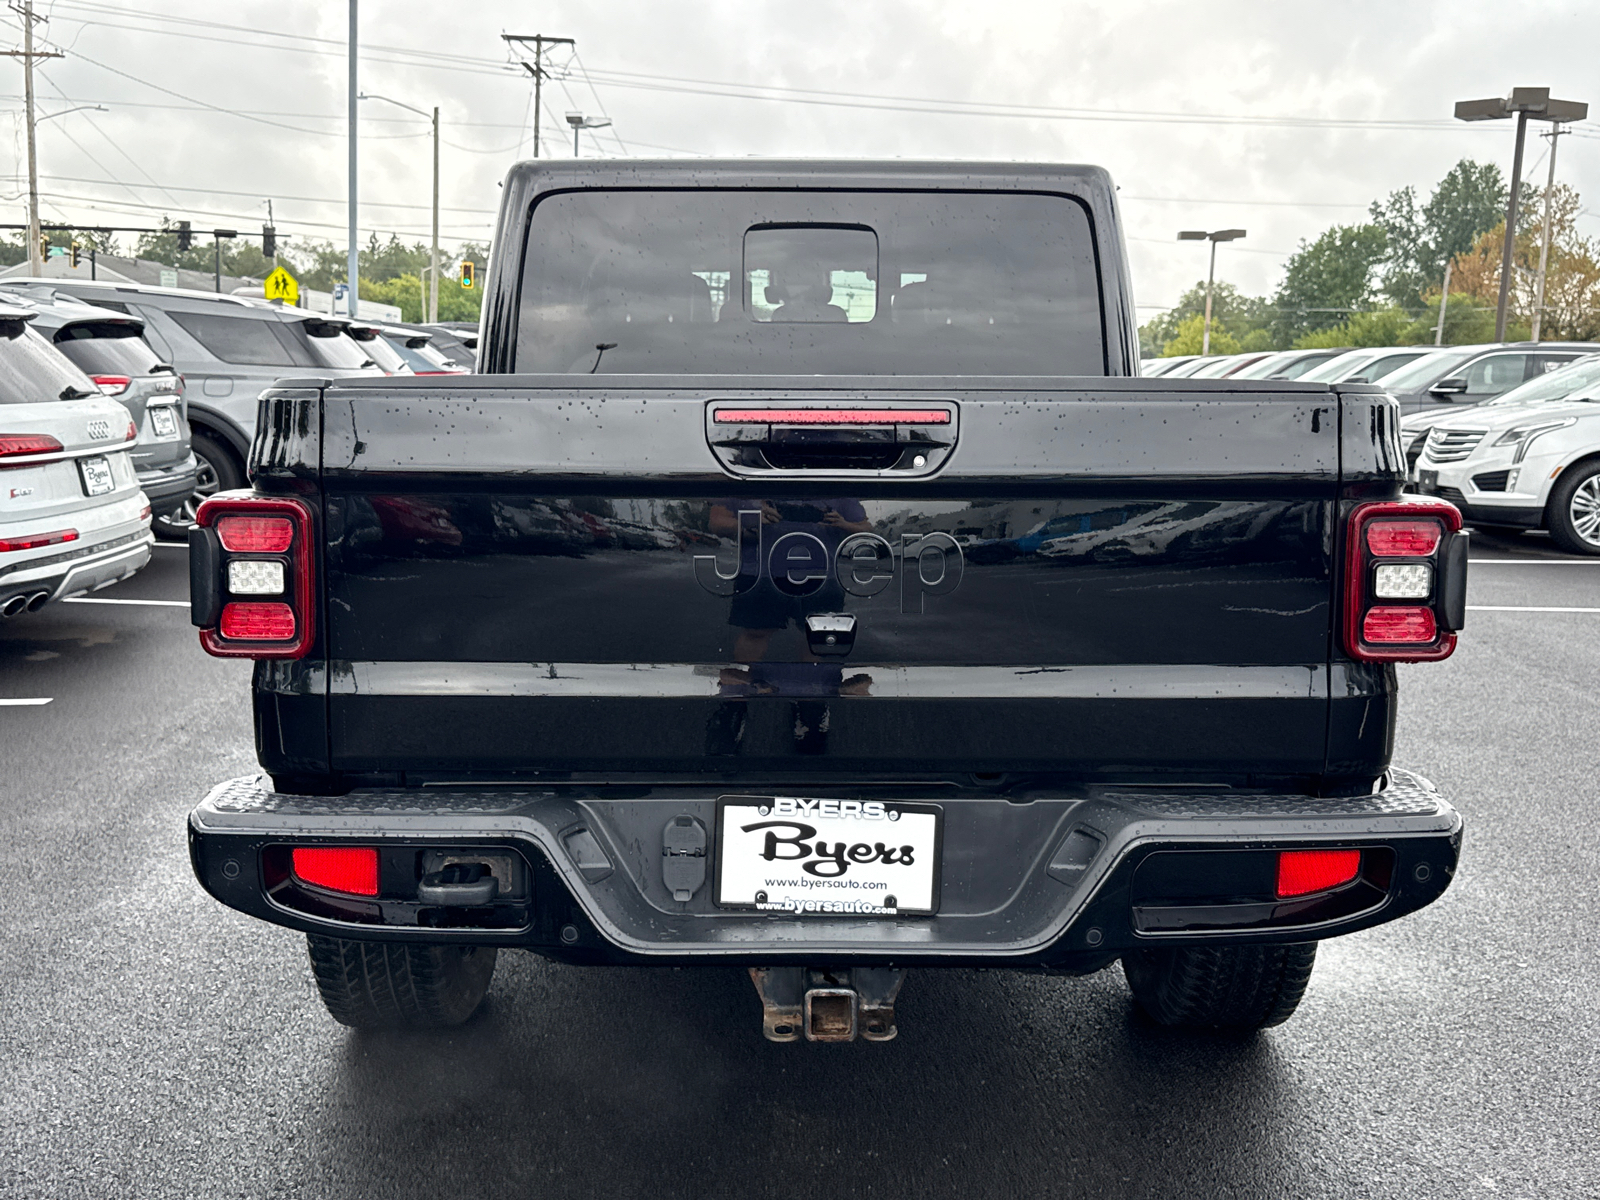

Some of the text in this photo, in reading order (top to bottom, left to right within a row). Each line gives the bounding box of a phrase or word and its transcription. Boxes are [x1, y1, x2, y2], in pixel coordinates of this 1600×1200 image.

[693, 510, 964, 613] Jeep
[773, 798, 886, 820] BYERS
[740, 820, 915, 878] Byers
[764, 877, 888, 890] www.byersauto.com
[755, 897, 897, 914] www.byersauto.com
